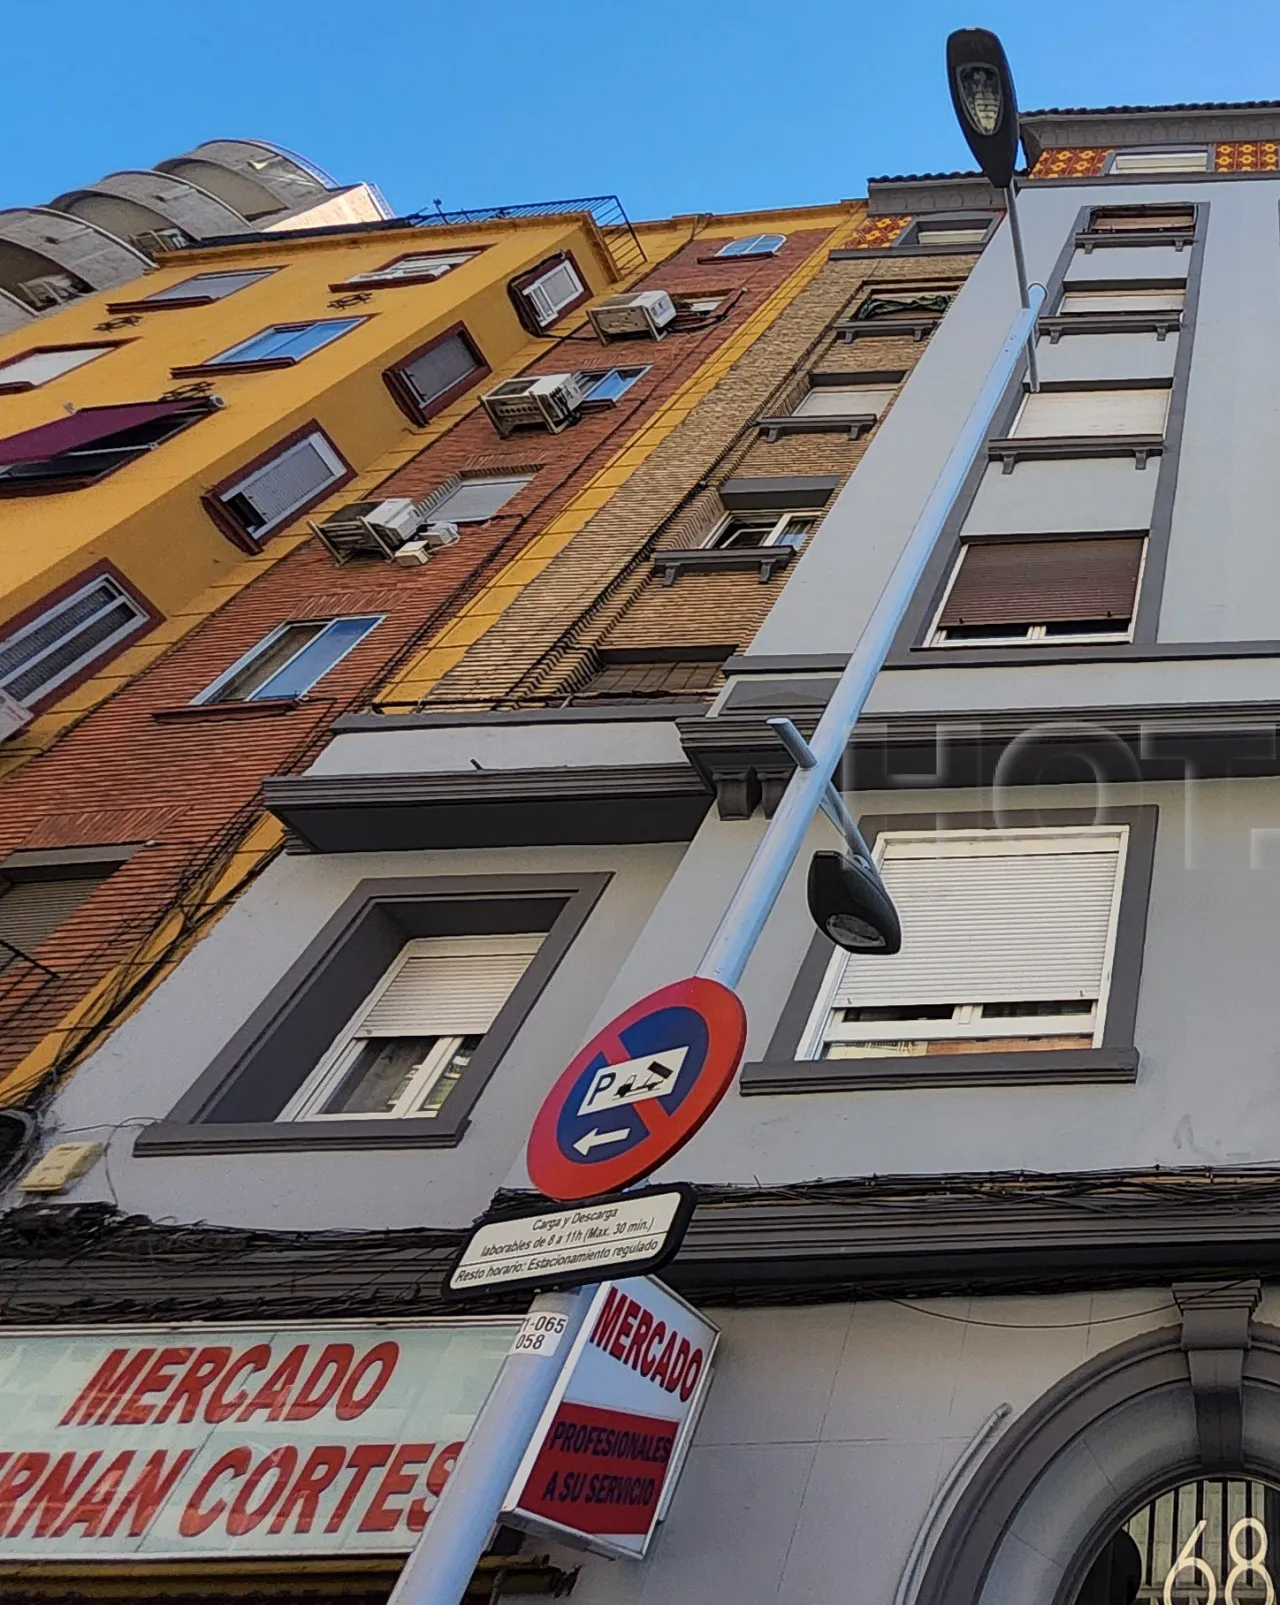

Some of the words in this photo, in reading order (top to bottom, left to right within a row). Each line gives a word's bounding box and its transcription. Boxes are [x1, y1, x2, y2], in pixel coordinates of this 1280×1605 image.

[587, 1072, 617, 1106] P
[480, 1239, 531, 1257] laborables
[533, 1235, 545, 1249] de
[547, 1233, 556, 1245] 8
[555, 1235, 563, 1245] a
[566, 1231, 583, 1244] 11h
[613, 1221, 627, 1235] 30
[532, 1217, 561, 1232] Carga
[561, 1216, 572, 1229] y
[571, 1208, 618, 1225] Descarga
[455, 1267, 485, 1283] Resto
[486, 1260, 527, 1279] horario:
[527, 1248, 611, 1271] Estacionamiento
[612, 1239, 659, 1259] regulado
[515, 1333, 546, 1350] 058
[589, 1286, 704, 1402] MERCADO
[58, 1340, 400, 1427] MERCADO
[550, 1421, 674, 1463] PROFESIONALES
[0, 1449, 196, 1539] RNAN
[543, 1470, 558, 1501] A
[559, 1471, 588, 1503] SU
[585, 1473, 657, 1506] SERVICIO
[1164, 1517, 1275, 1605] 68
